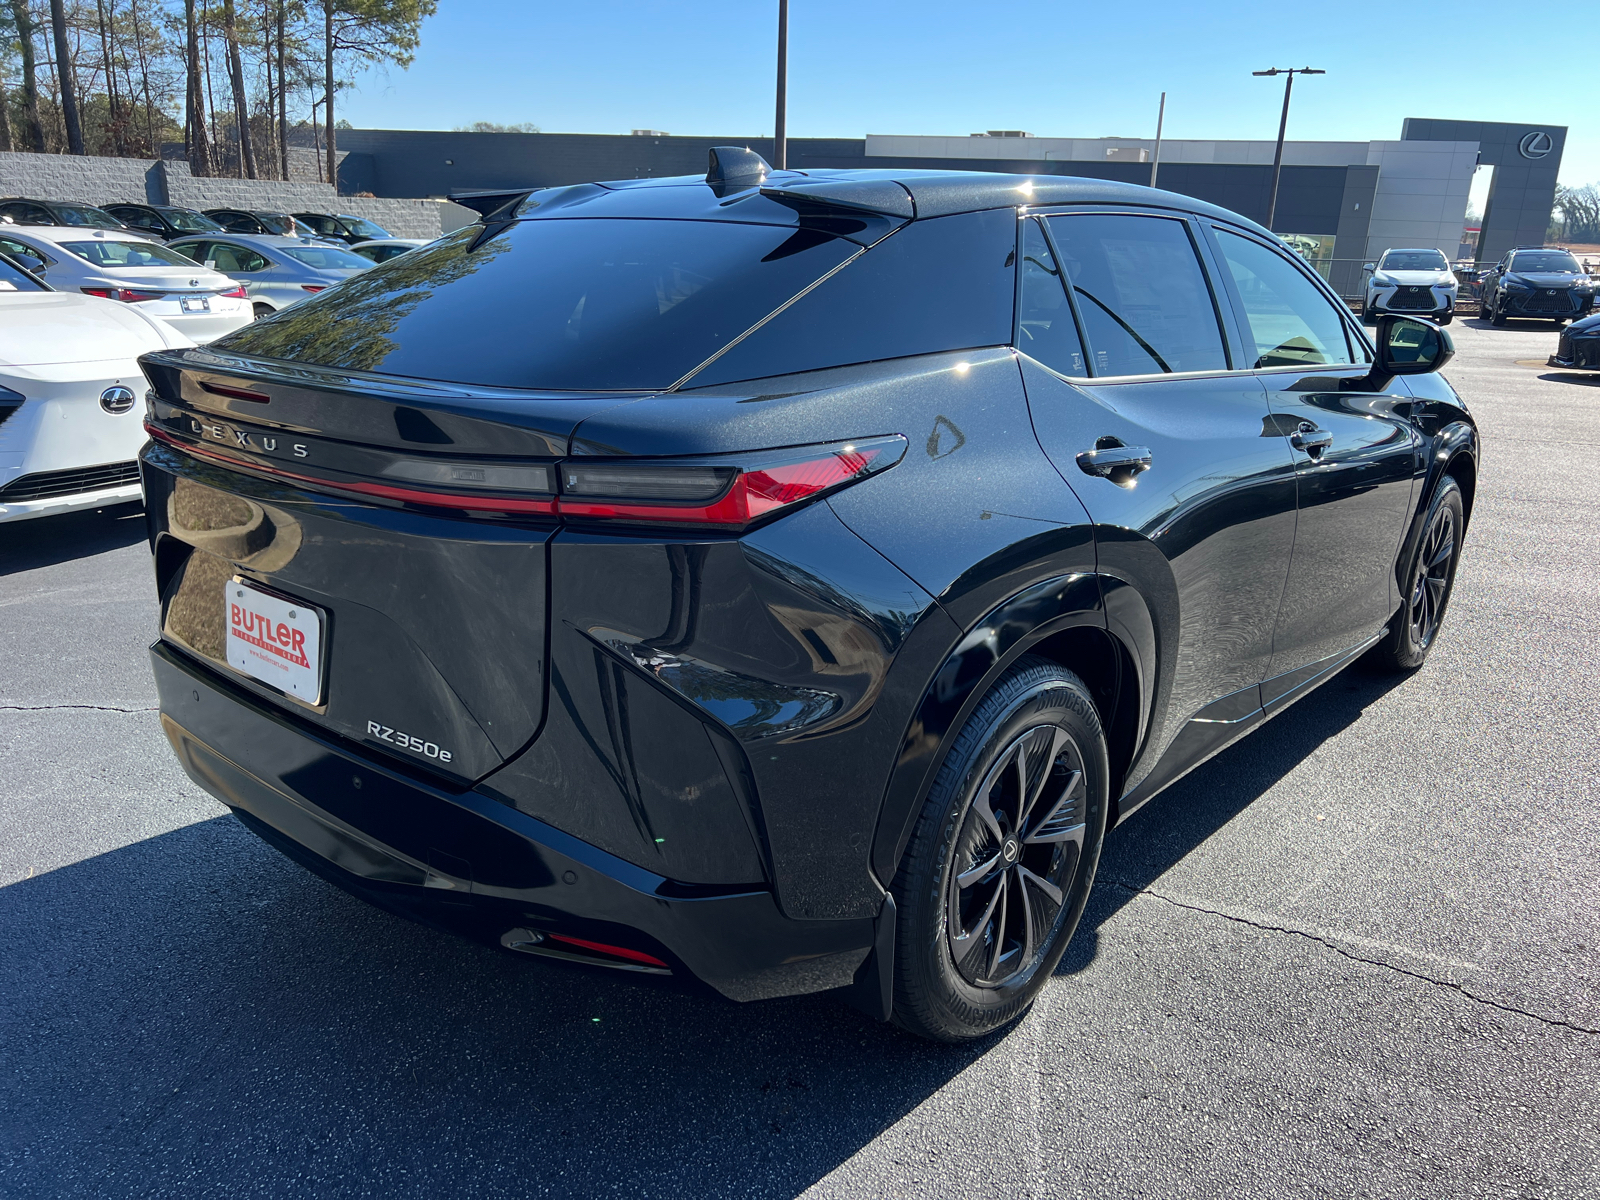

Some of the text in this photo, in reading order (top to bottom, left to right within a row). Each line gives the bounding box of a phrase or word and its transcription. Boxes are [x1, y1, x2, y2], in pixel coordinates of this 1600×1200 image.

[191, 420, 308, 458] LEXUS
[1034, 690, 1102, 744] BRIDGESTONE
[367, 720, 452, 763] RZ350e
